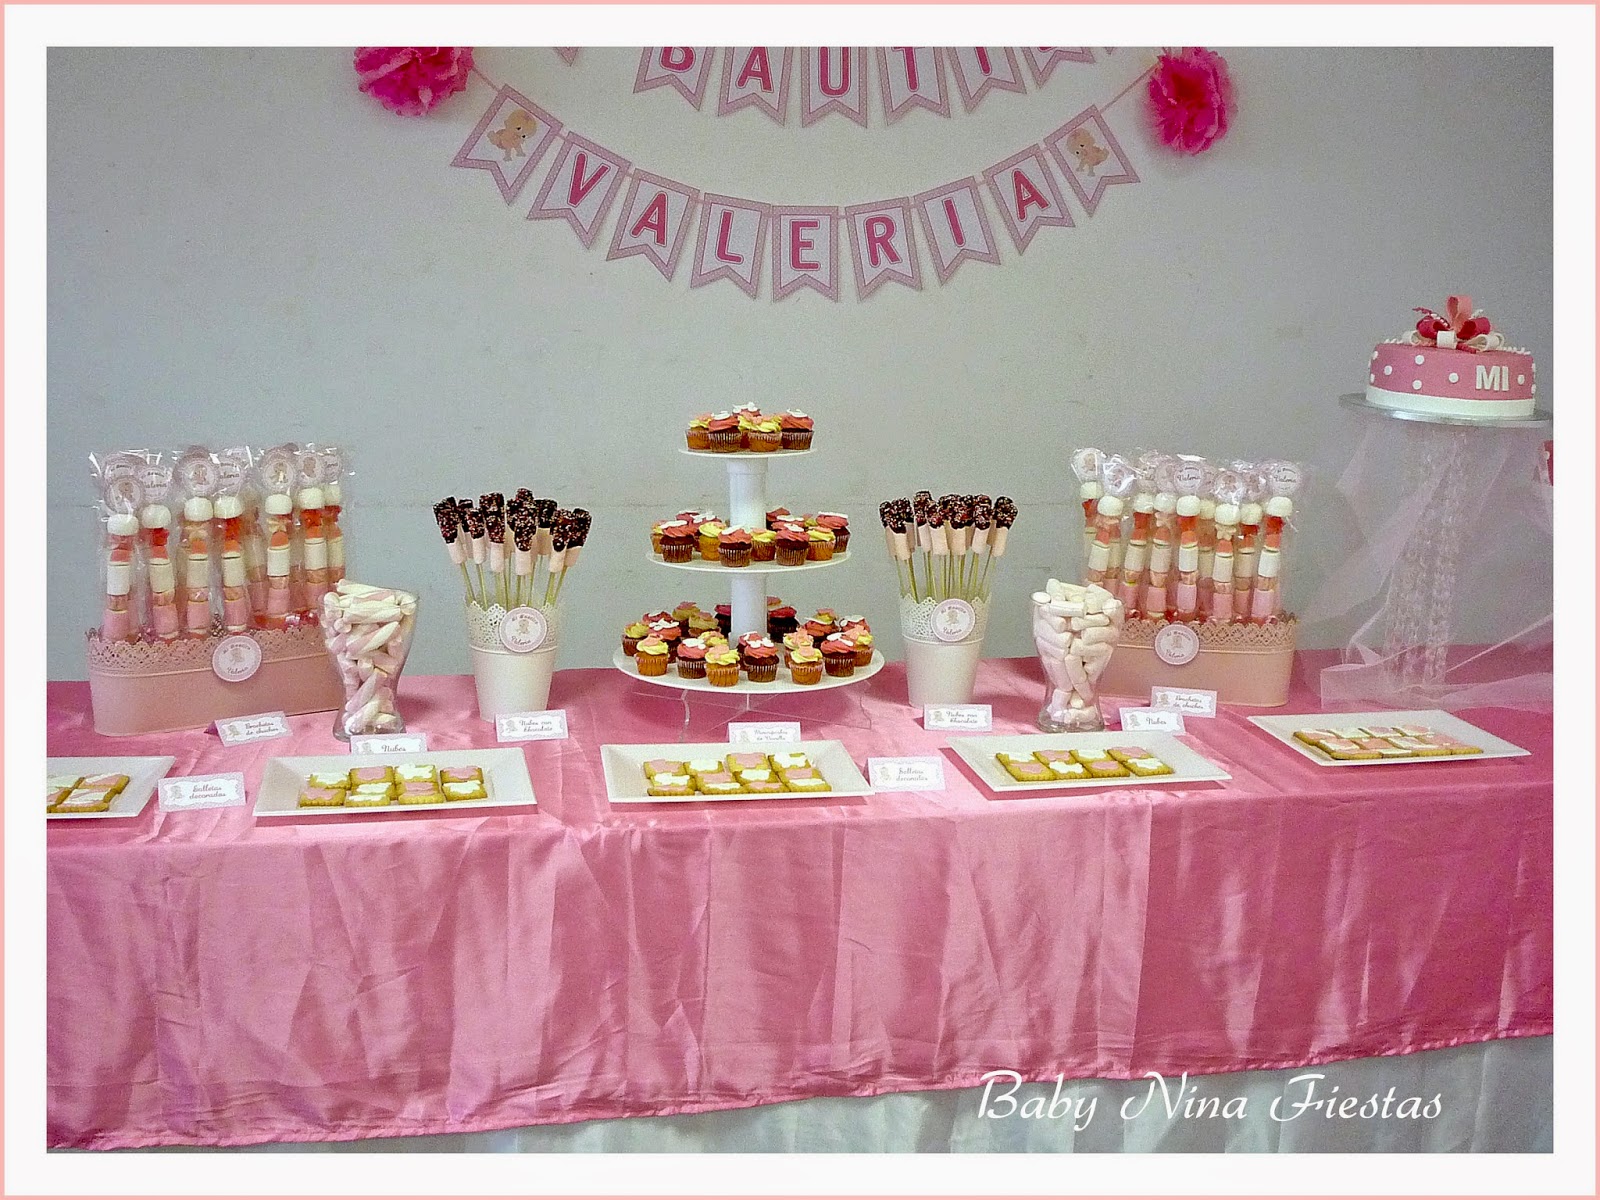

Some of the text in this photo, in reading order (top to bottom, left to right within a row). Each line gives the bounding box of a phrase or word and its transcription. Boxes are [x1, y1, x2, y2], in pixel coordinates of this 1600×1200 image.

[567, 152, 1050, 272] VALERIA
[1475, 364, 1510, 392] MI
[381, 744, 407, 752] Nubes
